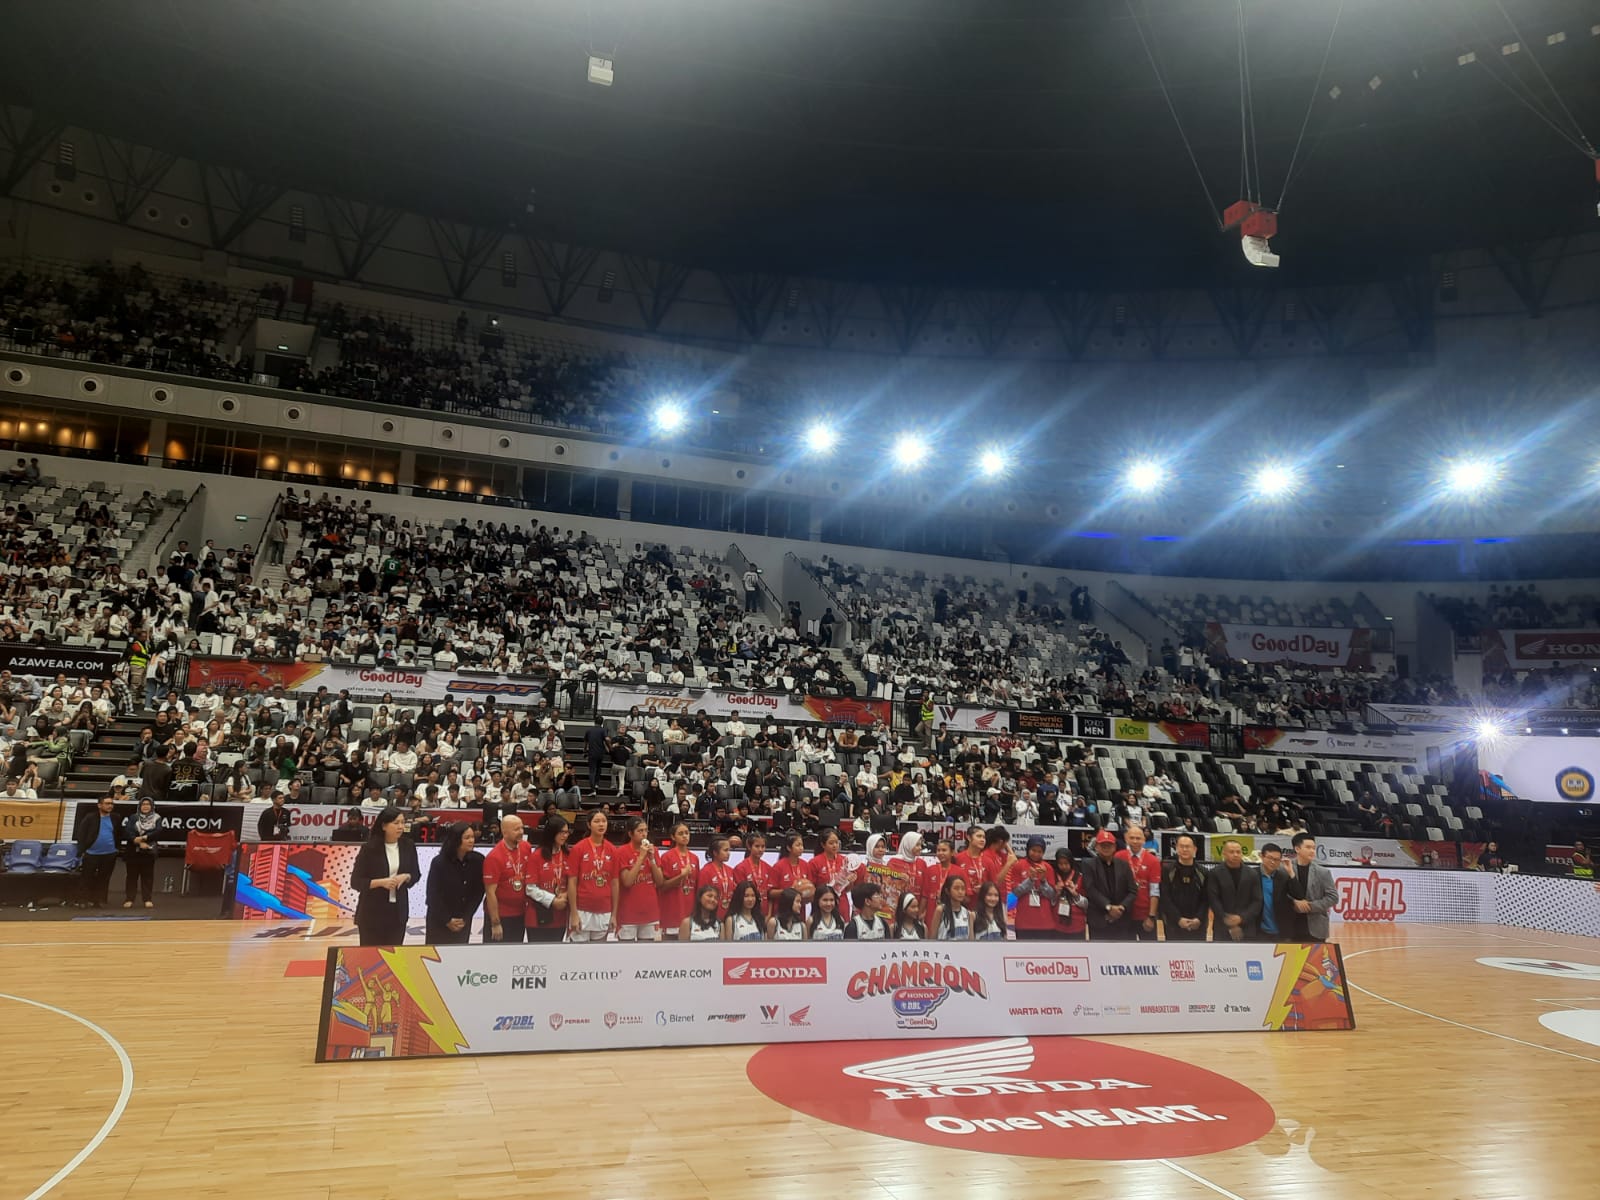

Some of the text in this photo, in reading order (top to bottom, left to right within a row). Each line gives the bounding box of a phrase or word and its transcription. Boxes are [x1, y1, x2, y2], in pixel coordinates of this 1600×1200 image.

[1252, 633, 1300, 652] Good
[1303, 634, 1340, 658] Day
[9, 656, 104, 671] AZAWEAR.COM
[359, 668, 395, 682] Good
[396, 671, 423, 688] Day
[727, 692, 755, 705] Good
[756, 694, 779, 709] Day
[1084, 726, 1104, 735] MEN
[1329, 849, 1353, 858] Biznet
[1337, 877, 1405, 911] FINAL
[880, 950, 951, 961] JAKARTA
[512, 965, 547, 975] POND'S
[1025, 961, 1056, 976] Good
[1056, 961, 1079, 978] Day
[1100, 965, 1158, 976] ULTRA MILK
[1168, 960, 1184, 970] HOT
[1203, 963, 1238, 974] Jackson
[634, 969, 712, 979] AZAWEAR.COM
[750, 966, 824, 979] HONDA
[1170, 970, 1195, 979] CREAM
[511, 976, 547, 989] MEN
[846, 960, 988, 1000] CHAMPION
[1008, 1007, 1063, 1016] WARTA KOTA
[669, 1015, 695, 1023] Biznet
[873, 1078, 1153, 1100] HONDA
[924, 1104, 1228, 1135] One HEART.
